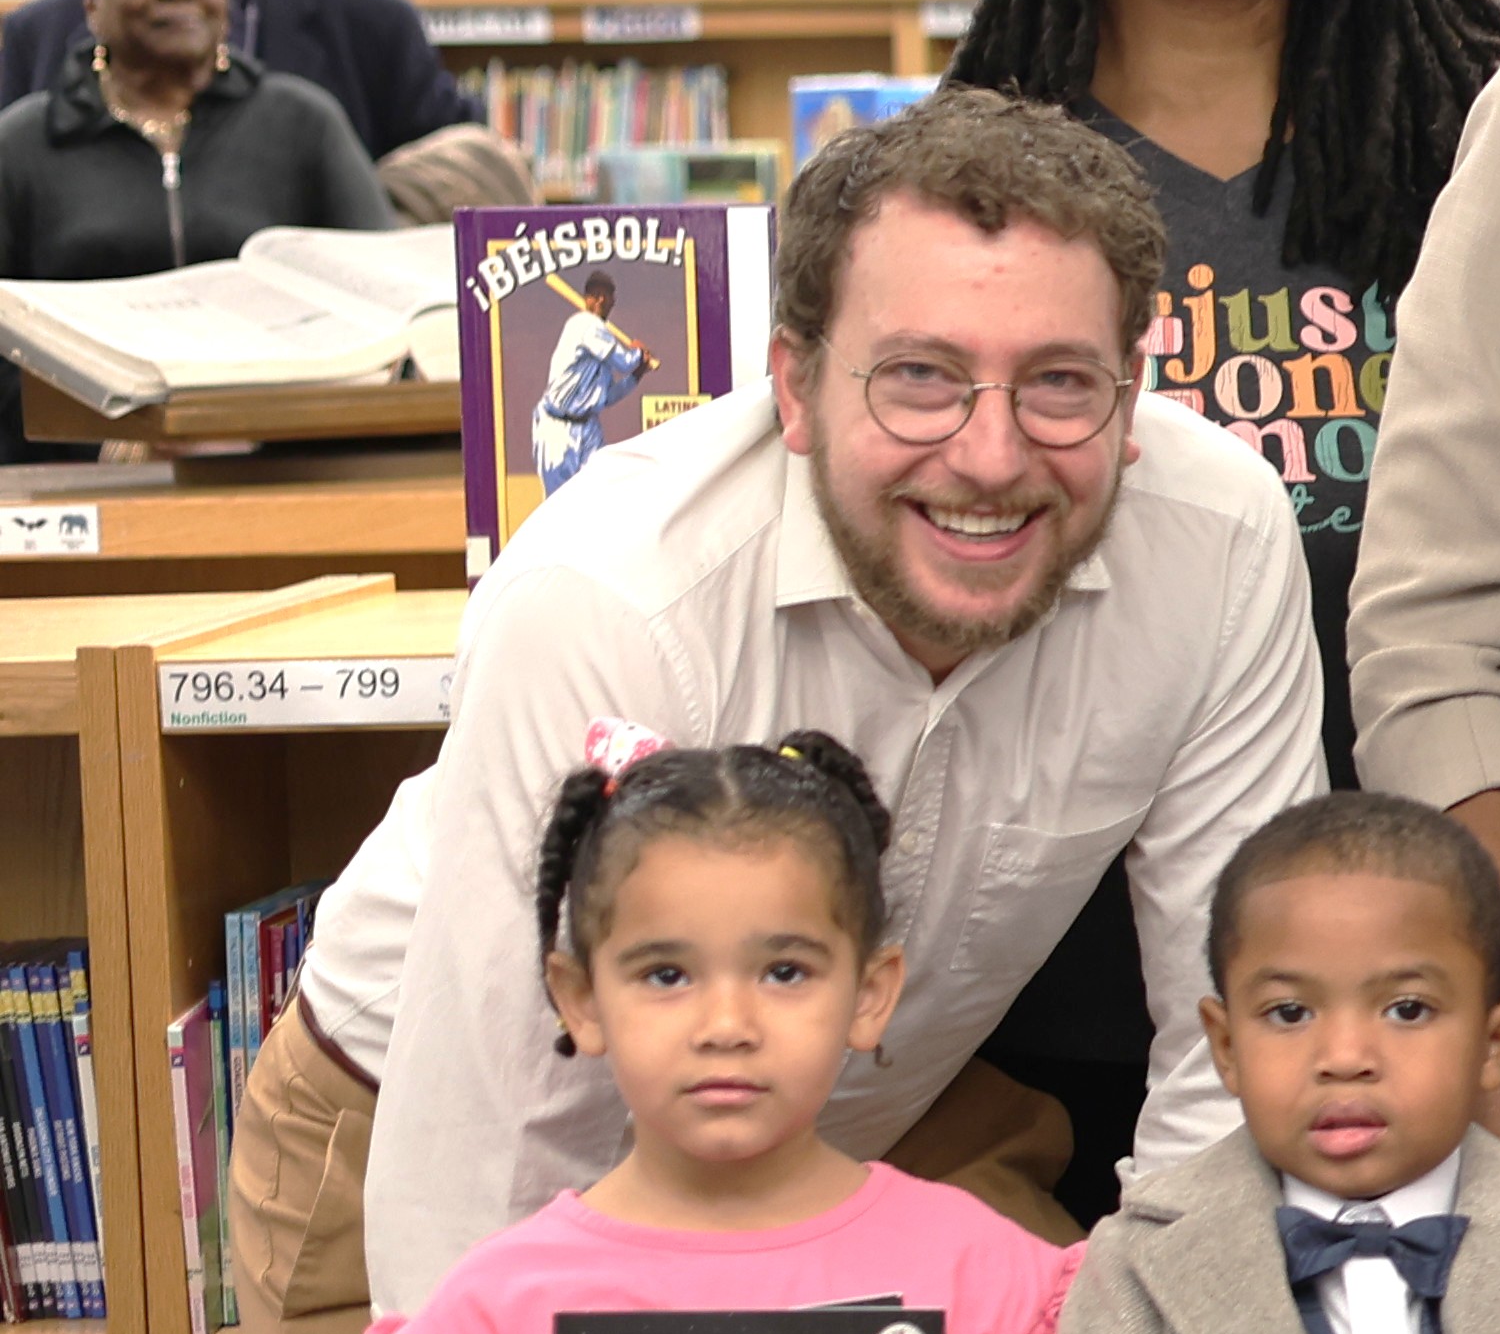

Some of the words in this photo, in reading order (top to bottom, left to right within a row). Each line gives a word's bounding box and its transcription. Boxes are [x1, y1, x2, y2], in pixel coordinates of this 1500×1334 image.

[463, 216, 686, 313] ¡BÉISBOL!
[168, 670, 289, 704] 796.34
[336, 667, 400, 700] 799
[170, 710, 248, 727] Nonfiction
